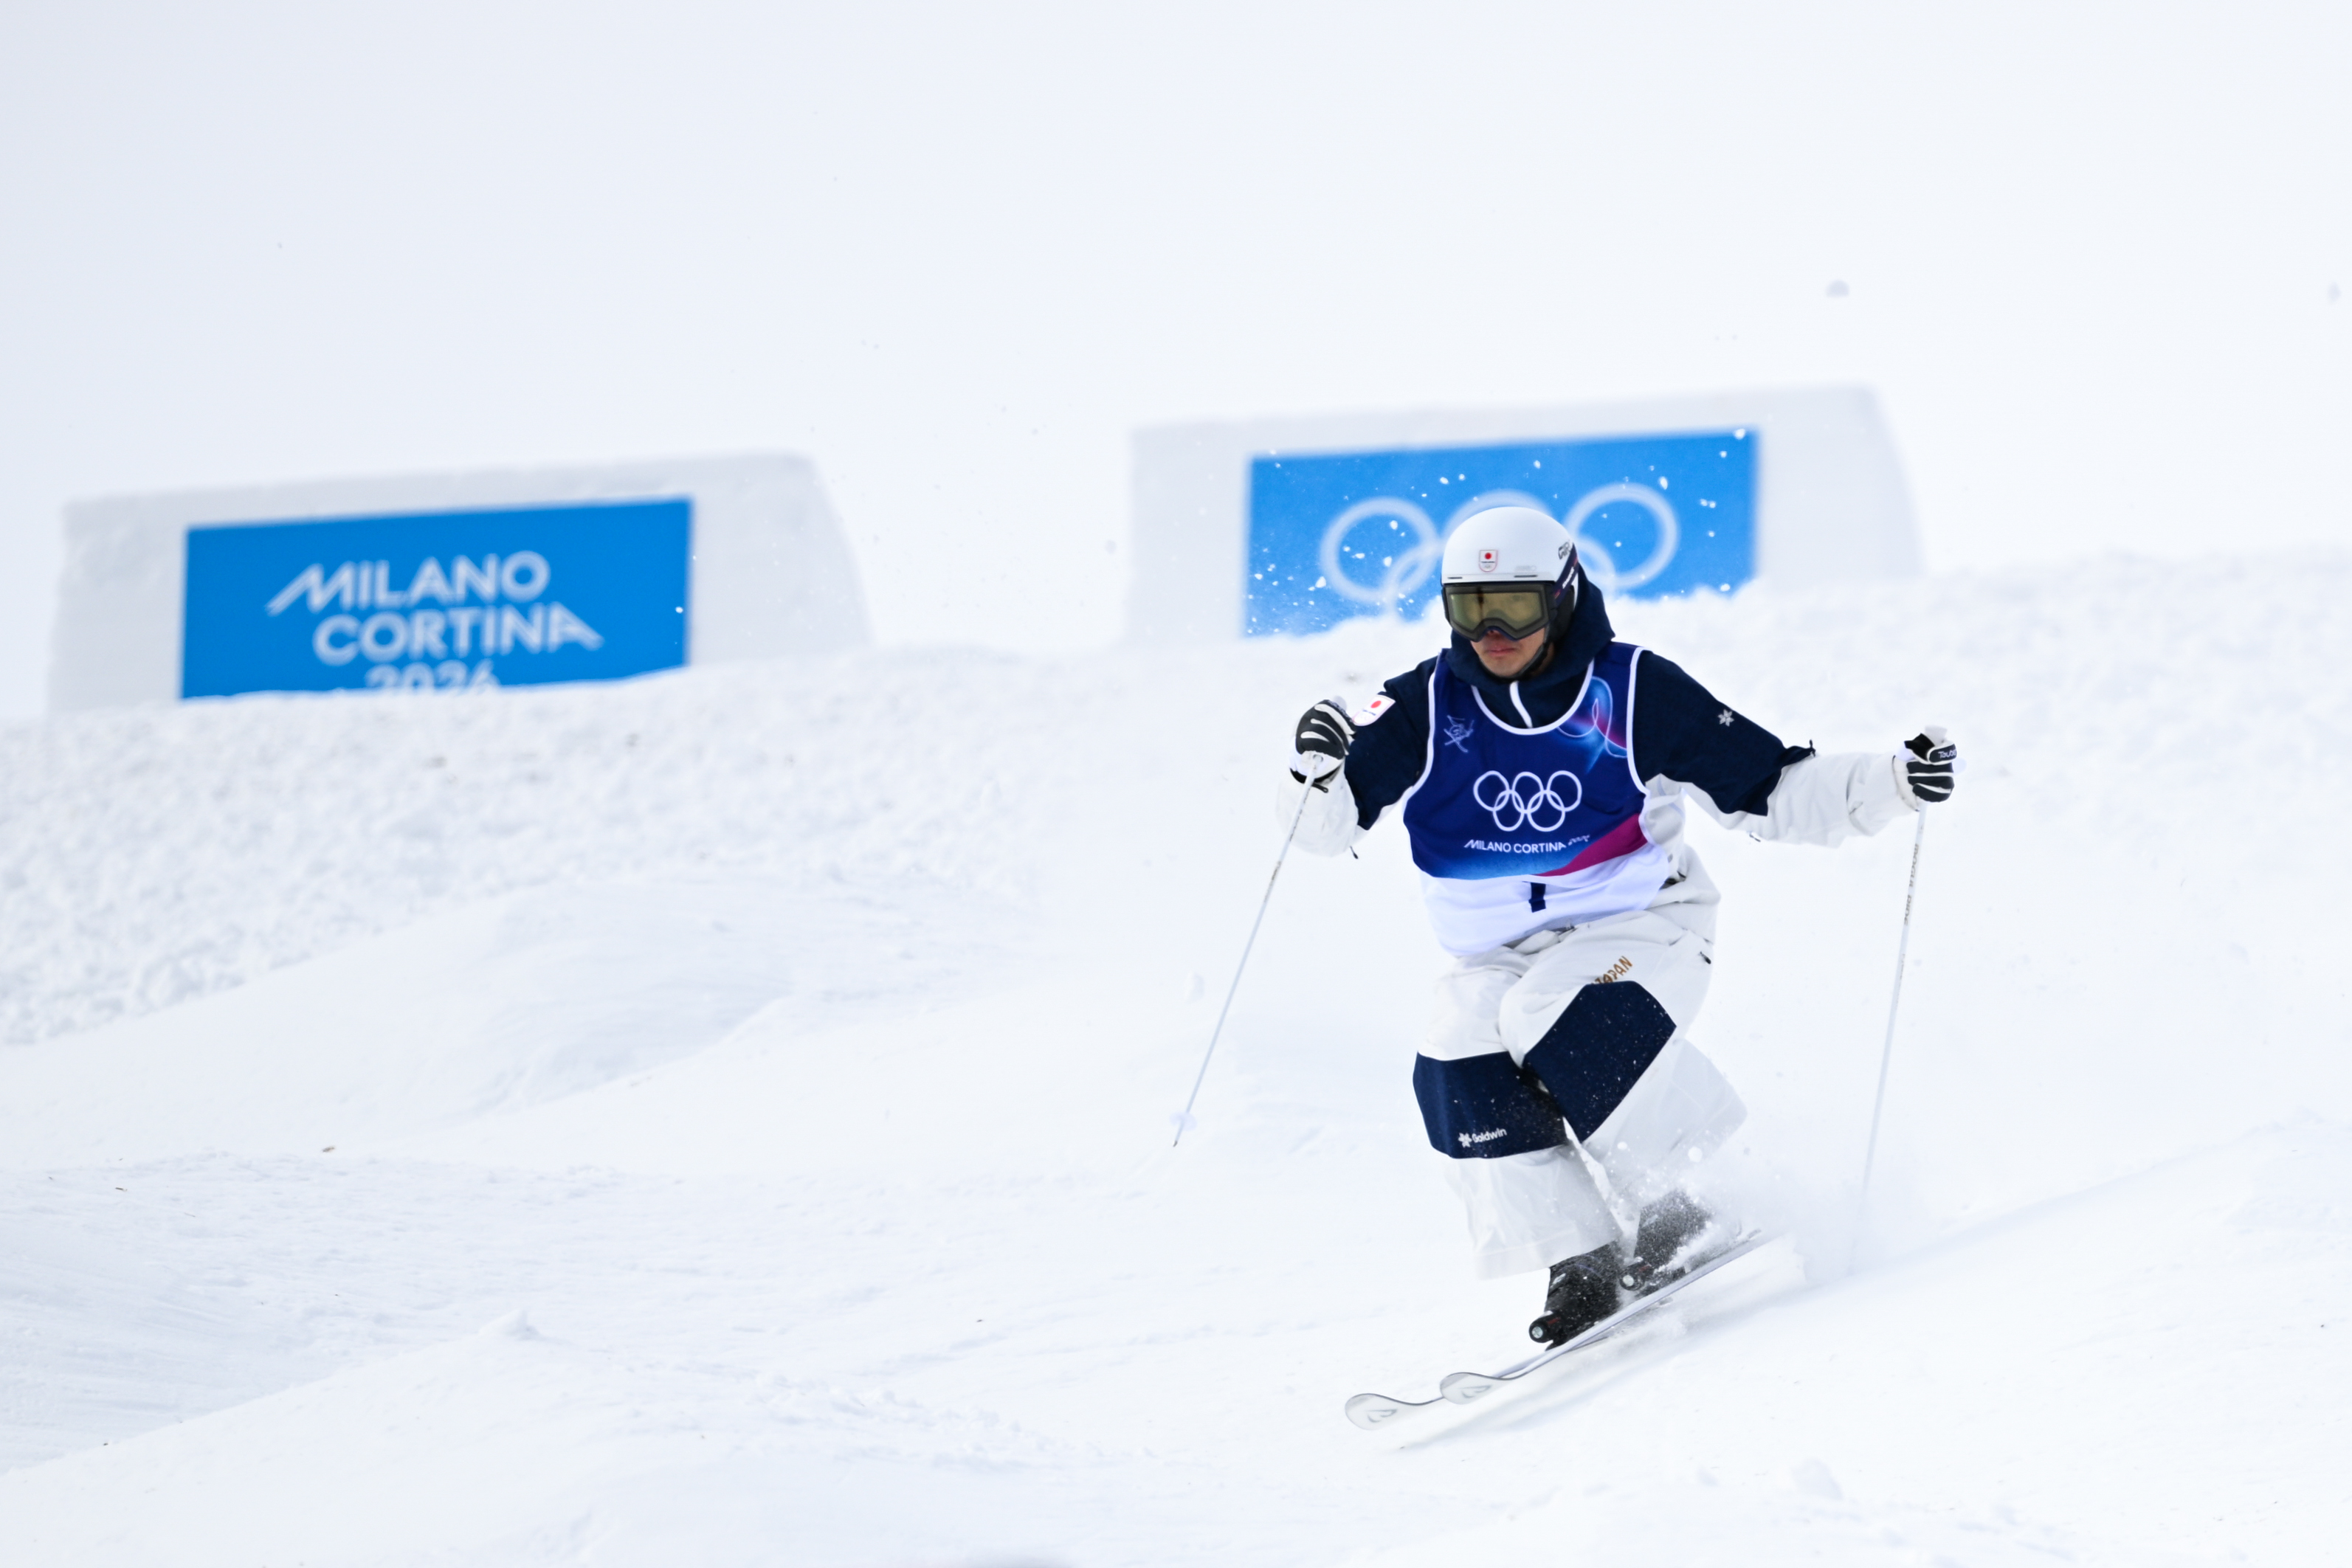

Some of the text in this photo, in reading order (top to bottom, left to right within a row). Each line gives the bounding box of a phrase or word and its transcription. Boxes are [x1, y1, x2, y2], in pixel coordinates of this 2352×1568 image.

[264, 550, 551, 616] MILANO
[312, 601, 605, 665] CORTINA
[1463, 839, 1567, 854] MILANO CORTINA
[1472, 1127, 1508, 1143] Goldwin
